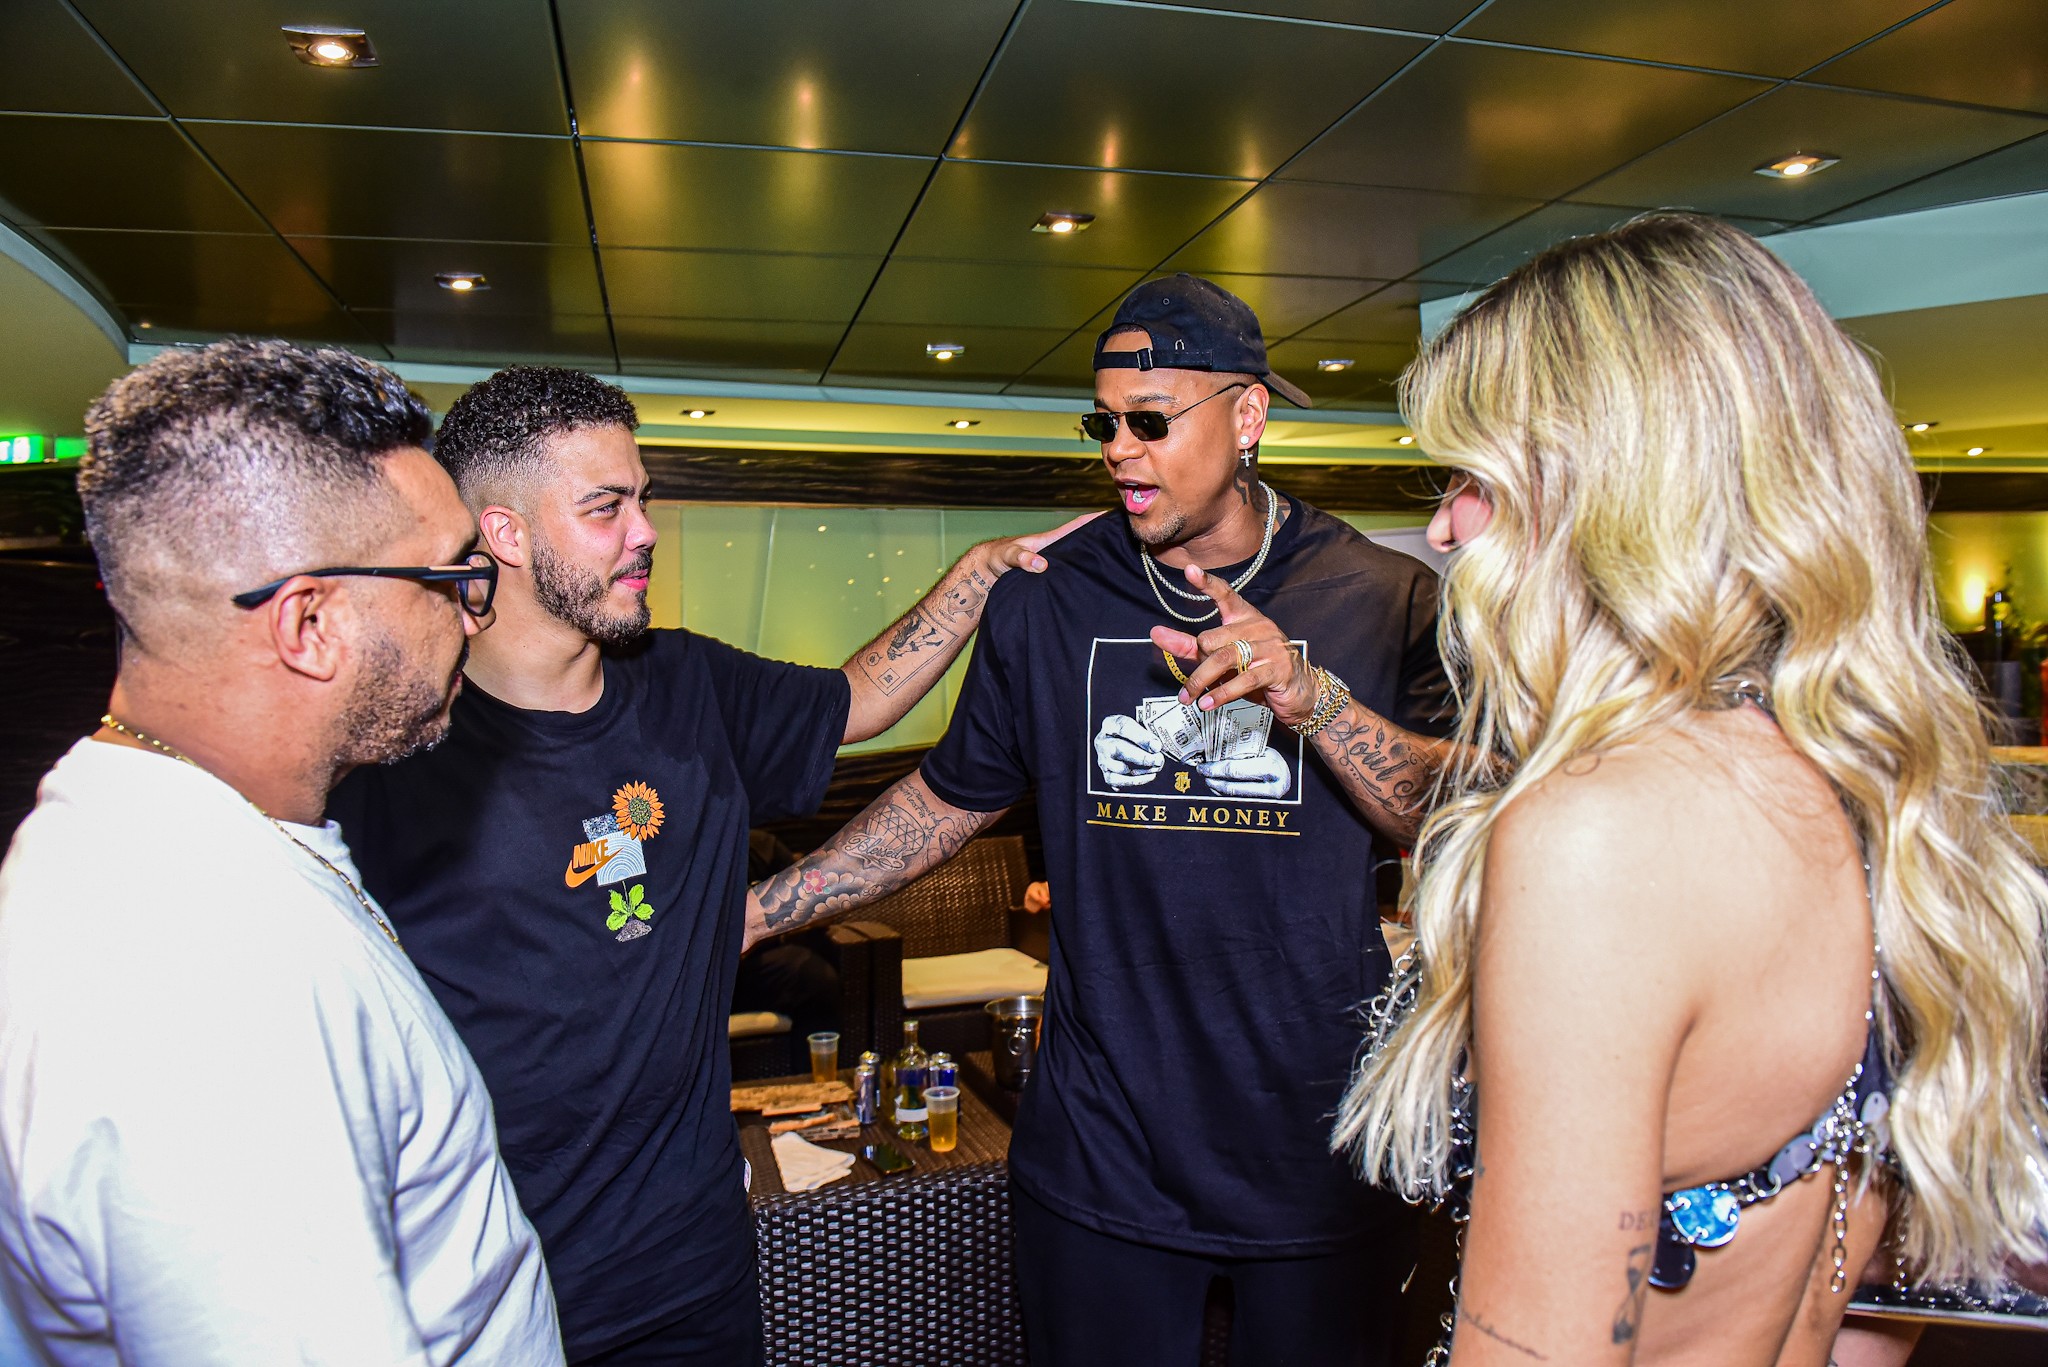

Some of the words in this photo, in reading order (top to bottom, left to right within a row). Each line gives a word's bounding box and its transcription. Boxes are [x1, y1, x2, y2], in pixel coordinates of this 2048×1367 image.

[1096, 801, 1168, 823] MAKE
[1187, 806, 1290, 828] MONEY
[573, 838, 609, 869] NIKE
[845, 833, 908, 859] Blessed
